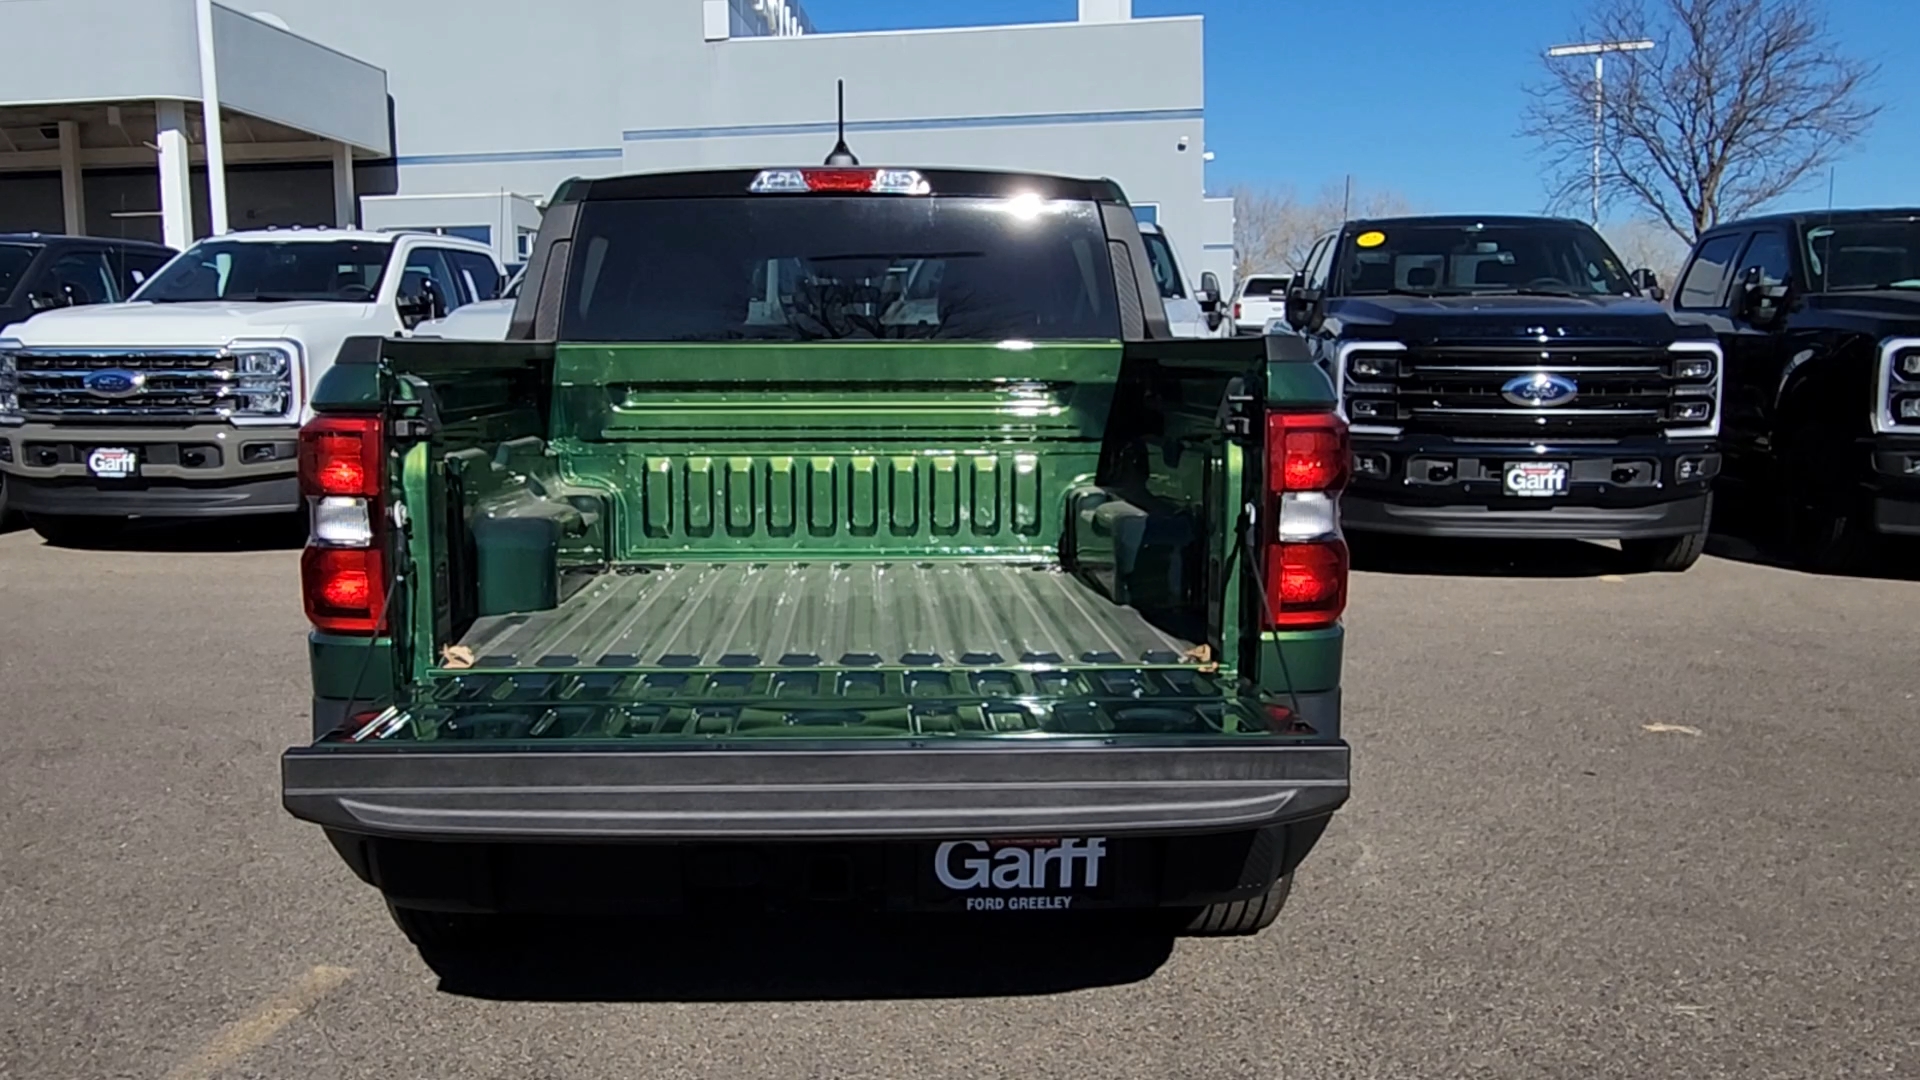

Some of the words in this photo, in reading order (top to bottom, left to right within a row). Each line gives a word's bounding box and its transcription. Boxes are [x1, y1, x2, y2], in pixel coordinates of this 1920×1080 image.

[89, 453, 135, 472] Garff
[1507, 468, 1565, 490] Garff
[935, 837, 1106, 889] Garff
[967, 898, 1004, 910] FORD
[1008, 896, 1072, 909] GREELEY
